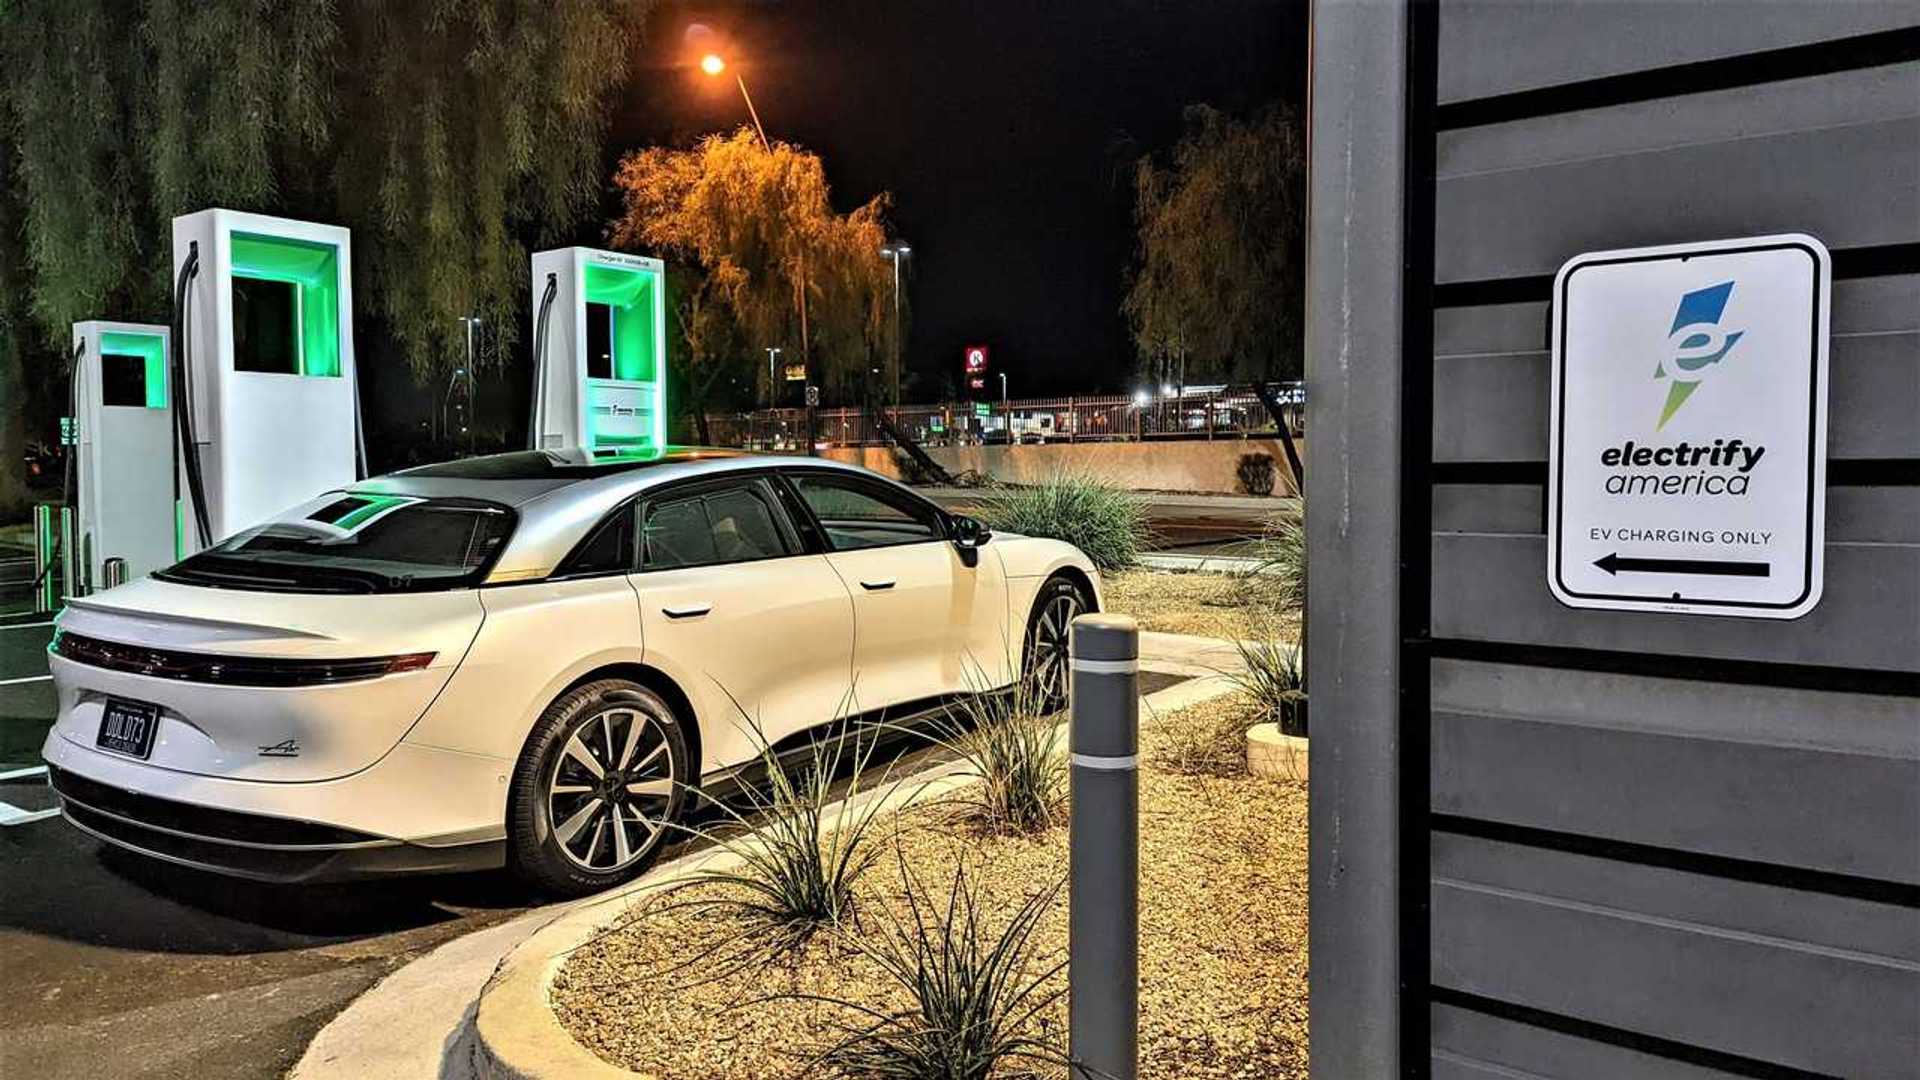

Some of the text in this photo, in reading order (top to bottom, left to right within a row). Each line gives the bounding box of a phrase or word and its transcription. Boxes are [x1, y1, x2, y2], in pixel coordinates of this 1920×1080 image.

[1601, 440, 1765, 472] electrify
[1605, 470, 1751, 495] america
[1590, 528, 1772, 544] EV CHARGING ONLY
